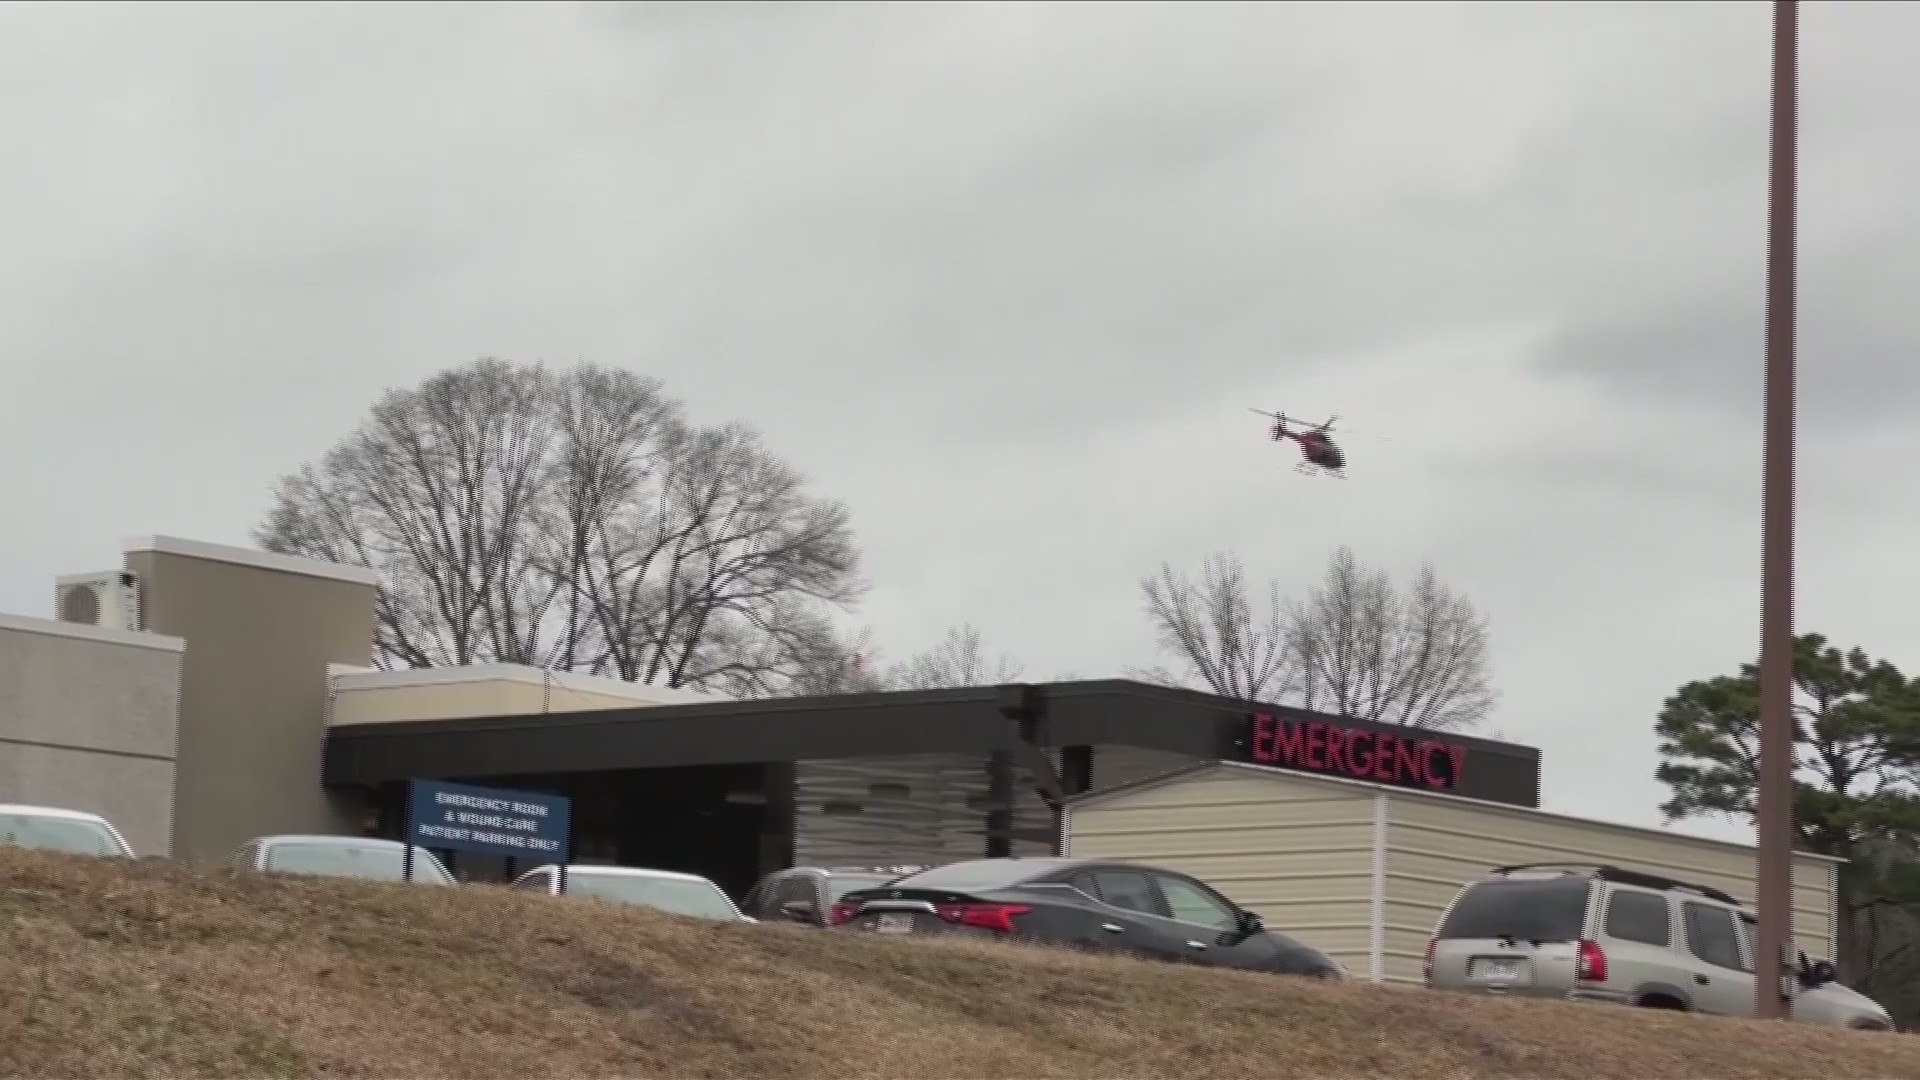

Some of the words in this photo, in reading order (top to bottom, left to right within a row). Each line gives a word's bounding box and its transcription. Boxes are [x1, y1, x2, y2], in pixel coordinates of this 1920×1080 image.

[1253, 712, 1468, 789] EMERGENCY
[434, 791, 511, 812] EMERGENCY
[511, 802, 549, 818] ROOM
[444, 810, 455, 822] &
[456, 812, 504, 828] WOUND
[503, 817, 539, 833] CARE
[418, 823, 471, 840] PATIENT
[471, 830, 528, 848] PARKING
[526, 837, 560, 852] ONLY
